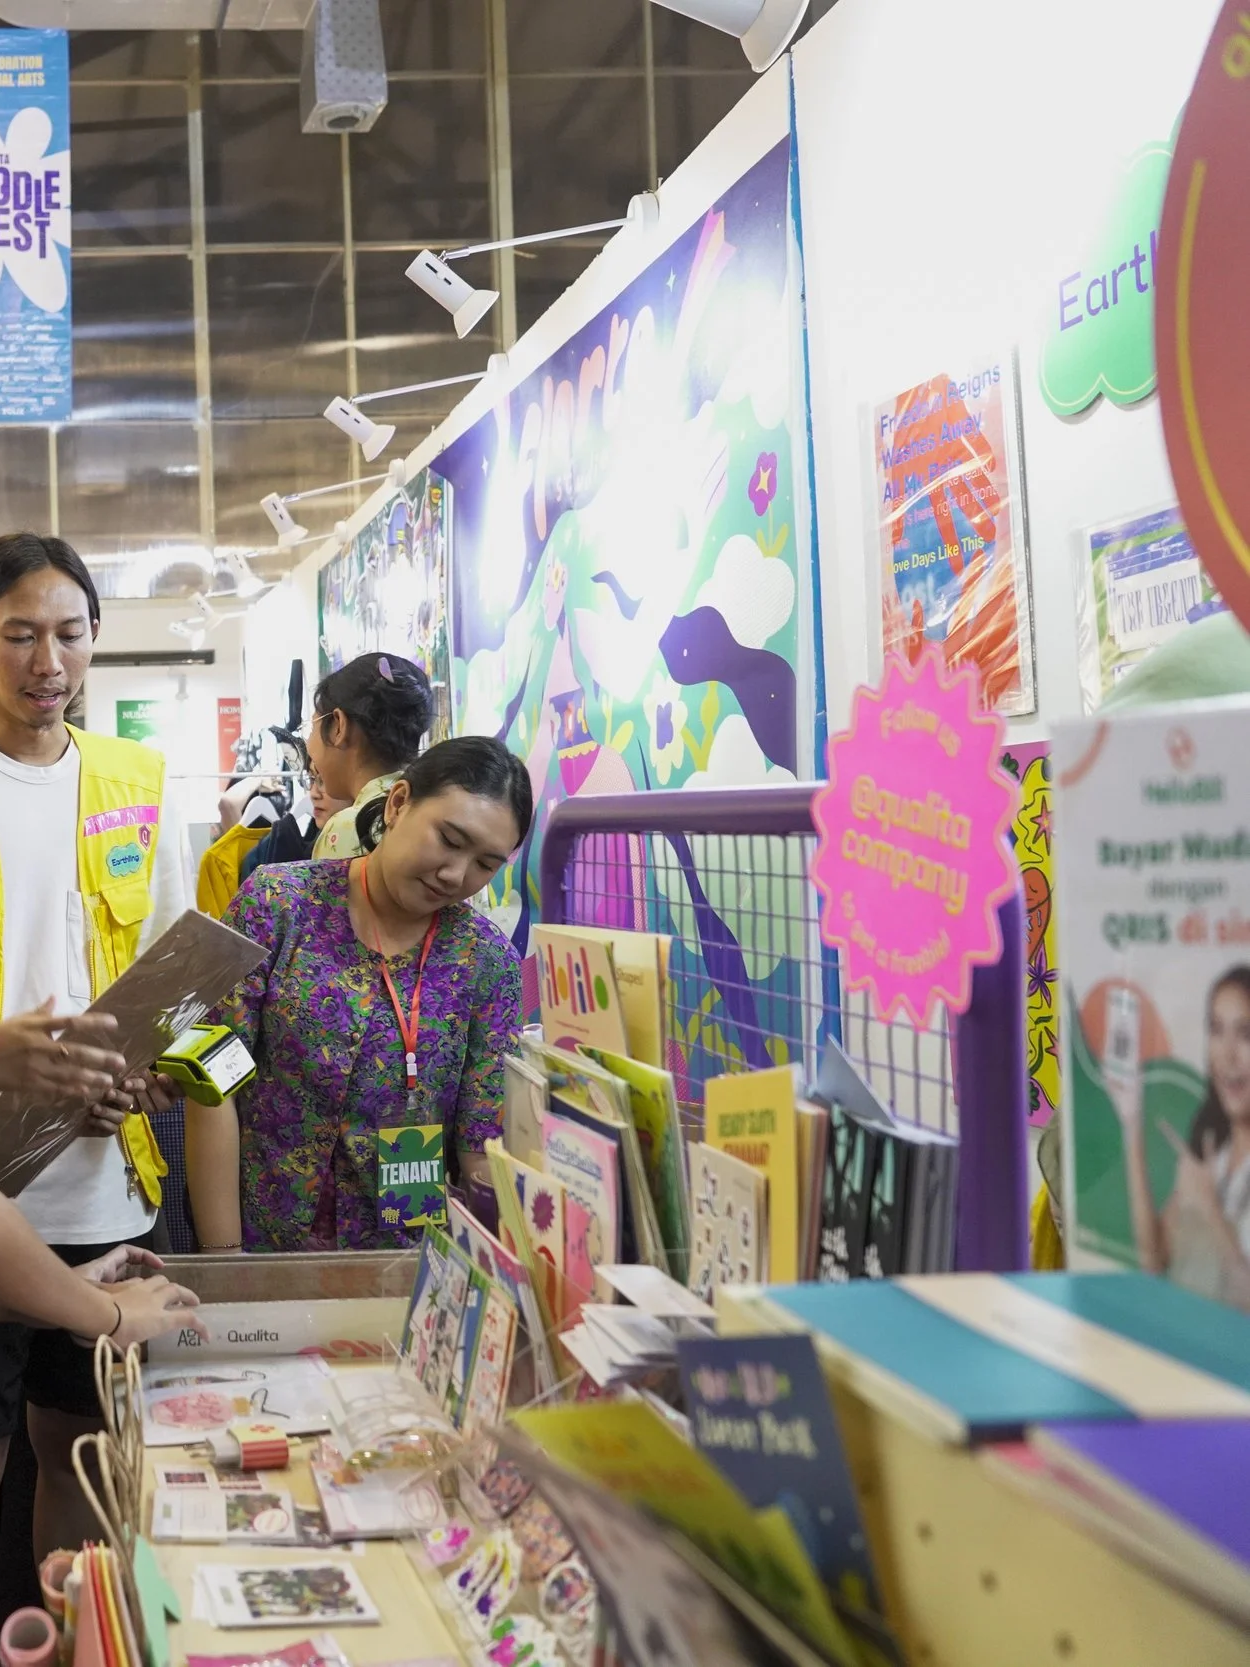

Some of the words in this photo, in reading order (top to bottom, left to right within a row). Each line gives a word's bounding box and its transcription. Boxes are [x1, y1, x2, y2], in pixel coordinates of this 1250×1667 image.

[17, 72, 45, 87] ARTS
[947, 364, 1001, 408] Reigns
[881, 433, 936, 470] Washes
[940, 411, 982, 446] Away
[959, 492, 969, 507] in
[912, 551, 936, 569] Days
[938, 543, 960, 561] Like
[961, 534, 985, 553] This
[852, 774, 971, 849] @qualita
[111, 855, 140, 867] Earthling
[841, 828, 969, 915] company
[1098, 838, 1174, 872] Bayar
[1104, 911, 1169, 949] QRIS
[380, 1160, 440, 1186] TENANT
[227, 1328, 279, 1343] Qualita
